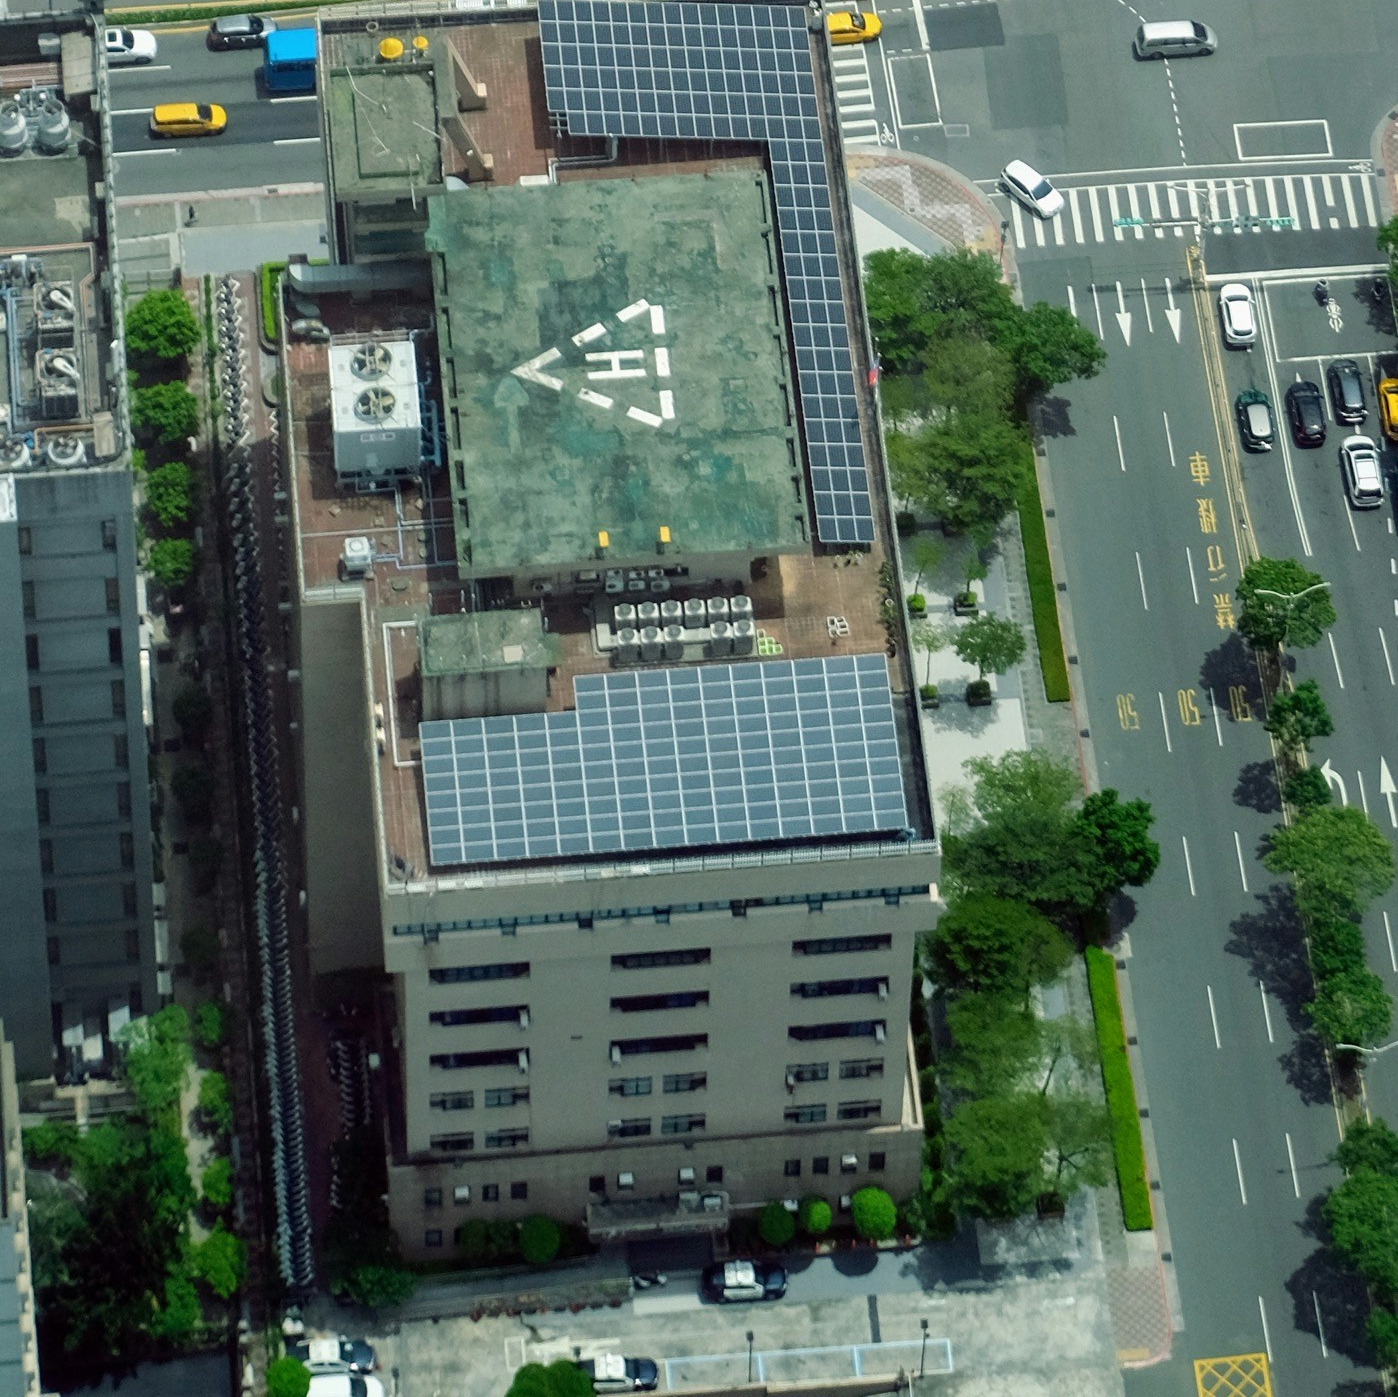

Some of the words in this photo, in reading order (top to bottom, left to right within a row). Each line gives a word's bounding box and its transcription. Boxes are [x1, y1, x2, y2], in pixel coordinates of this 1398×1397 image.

[585, 349, 646, 381] H
[1188, 450, 1236, 630] 禁行機車
[1116, 692, 1141, 731] 50
[1177, 688, 1201, 726] 50
[1228, 684, 1253, 722] 50
